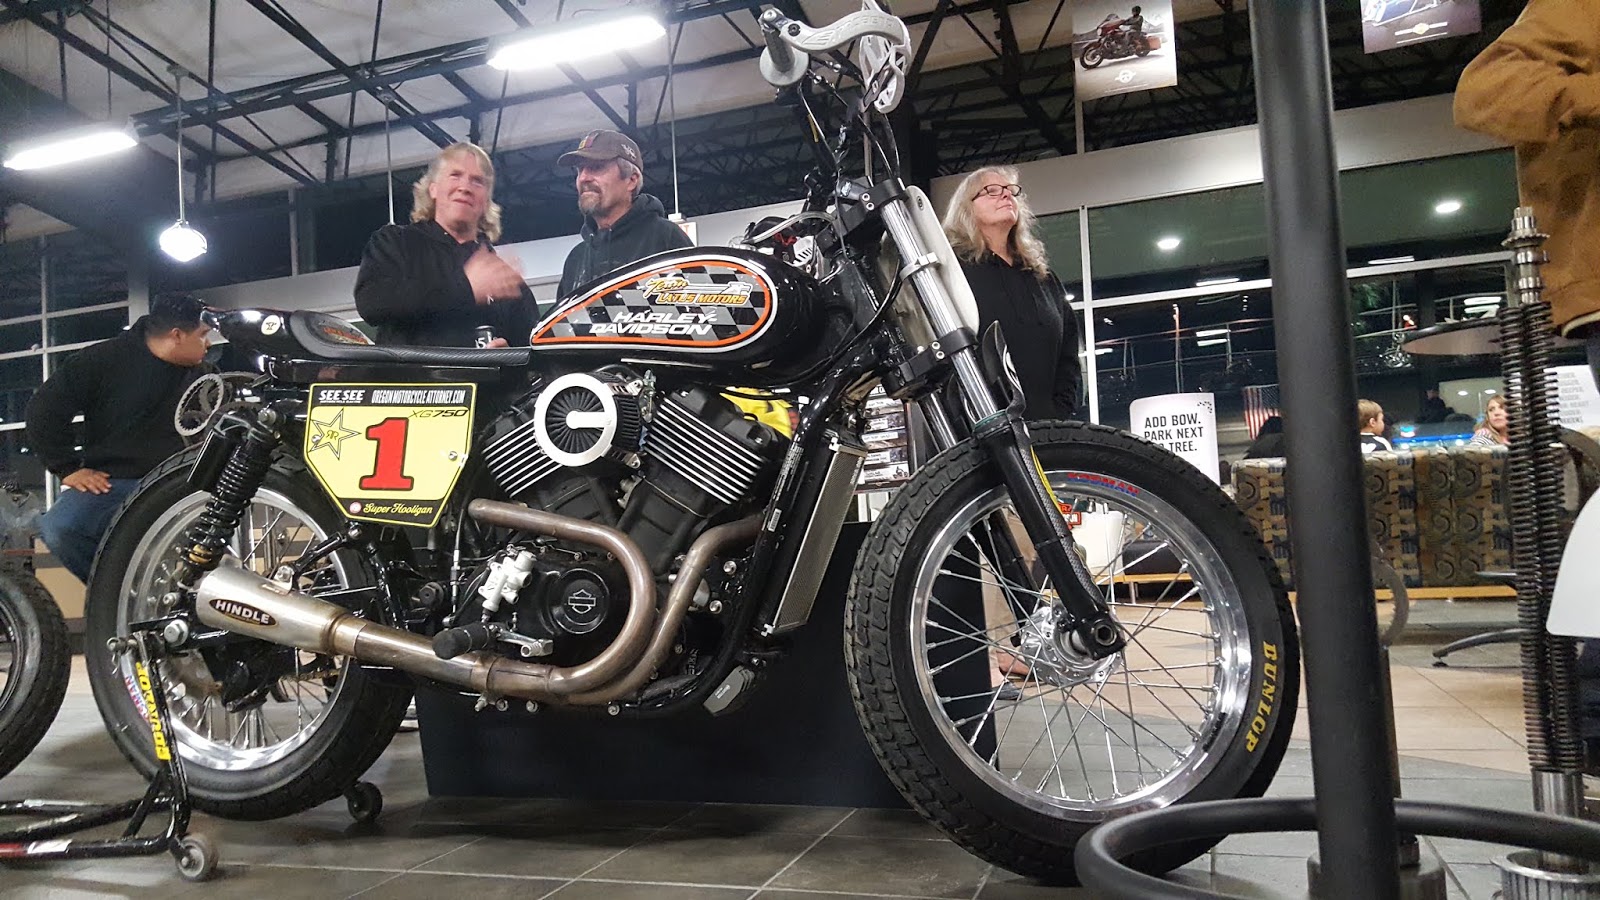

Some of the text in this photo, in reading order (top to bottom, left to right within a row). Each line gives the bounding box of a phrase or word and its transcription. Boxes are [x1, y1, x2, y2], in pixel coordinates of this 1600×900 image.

[696, 294, 748, 304] MOTORS
[589, 323, 712, 335] DAVIDSON
[319, 390, 365, 401] SEE SEE
[407, 409, 469, 418] XG750
[1145, 412, 1201, 428] ADD BOW.
[1144, 426, 1203, 441] PARK NEXT
[1168, 440, 1197, 453] TREE.
[359, 417, 414, 491] 1
[363, 502, 433, 516] Super Hooligan
[215, 600, 270, 624] HINDLE
[1246, 641, 1277, 752] DUNLOP
